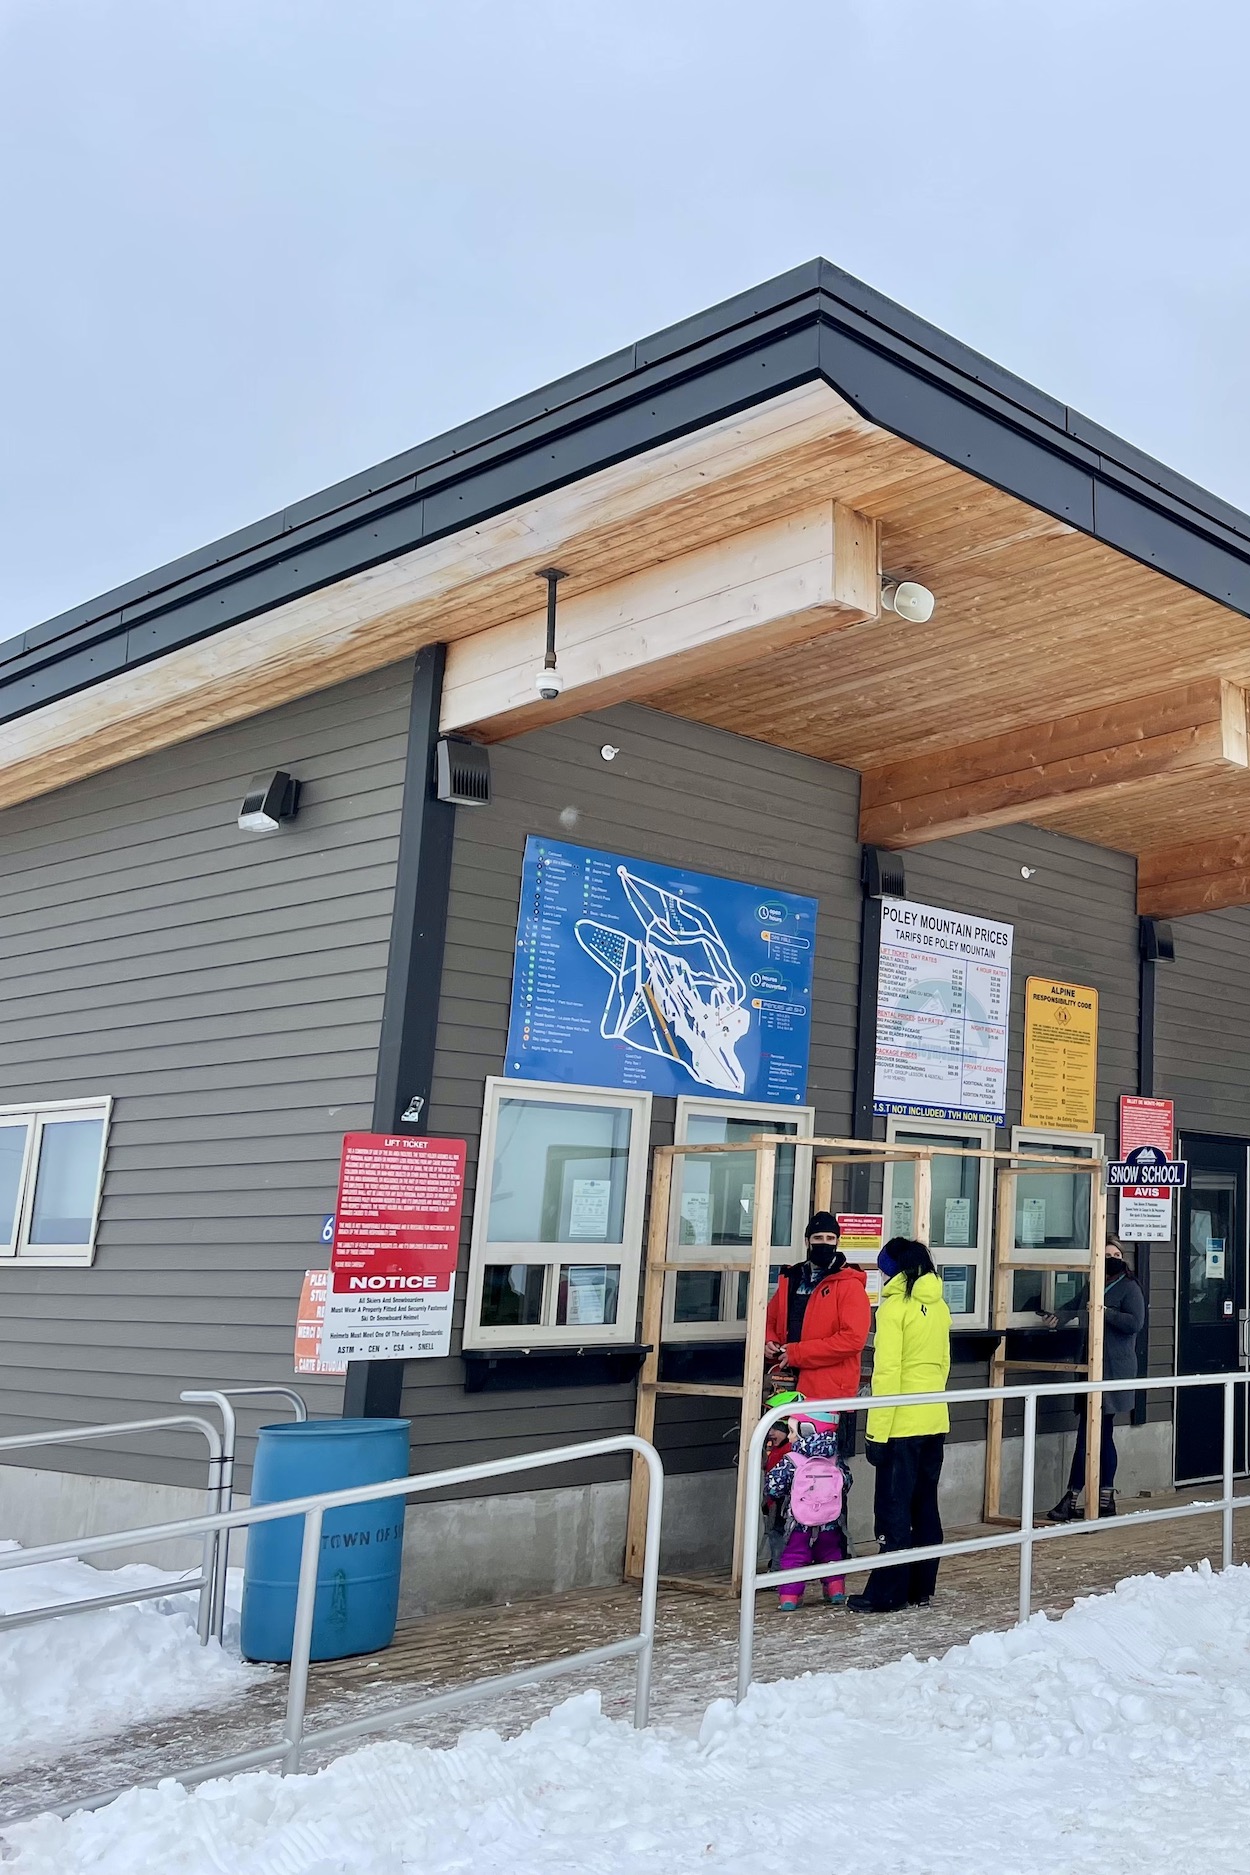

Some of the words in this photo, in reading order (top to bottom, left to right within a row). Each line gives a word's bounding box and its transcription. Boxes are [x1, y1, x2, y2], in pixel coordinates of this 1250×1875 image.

[883, 907, 917, 926] POLEY
[920, 915, 972, 937] MOUNTAIN
[975, 928, 1008, 946] PRICES
[896, 930, 921, 943] TARIFS
[924, 936, 933, 946] DE
[935, 938, 958, 952] POLEY
[960, 945, 995, 958] MOUNTAIN
[892, 950, 908, 958] TICKET
[922, 955, 937, 963] RATES
[762, 983, 786, 991] d'ouverture
[1051, 987, 1075, 997] ALPINE
[1033, 994, 1075, 1006] RESPONSIBILITY
[878, 1010, 896, 1018] RENTAL
[876, 1048, 898, 1057] PACKAGE
[900, 1051, 917, 1059] PRICES
[893, 1105, 906, 1114] NOT
[909, 1107, 946, 1118] INCLUDED/
[948, 1110, 961, 1119] TVH
[963, 1112, 976, 1121] NON
[979, 1113, 1003, 1123] INCLUS
[1111, 1166, 1139, 1183] SNOW
[1142, 1166, 1180, 1182] SCHOOL
[1135, 1188, 1159, 1196] AVIS
[323, 1217, 334, 1241] 6
[310, 1274, 326, 1286] PLEA
[350, 1276, 437, 1289] NOTICE
[298, 1327, 315, 1339] MERCI
[299, 1359, 315, 1372] CARTE
[322, 1531, 370, 1549] TOWN
[376, 1528, 390, 1542] OF
